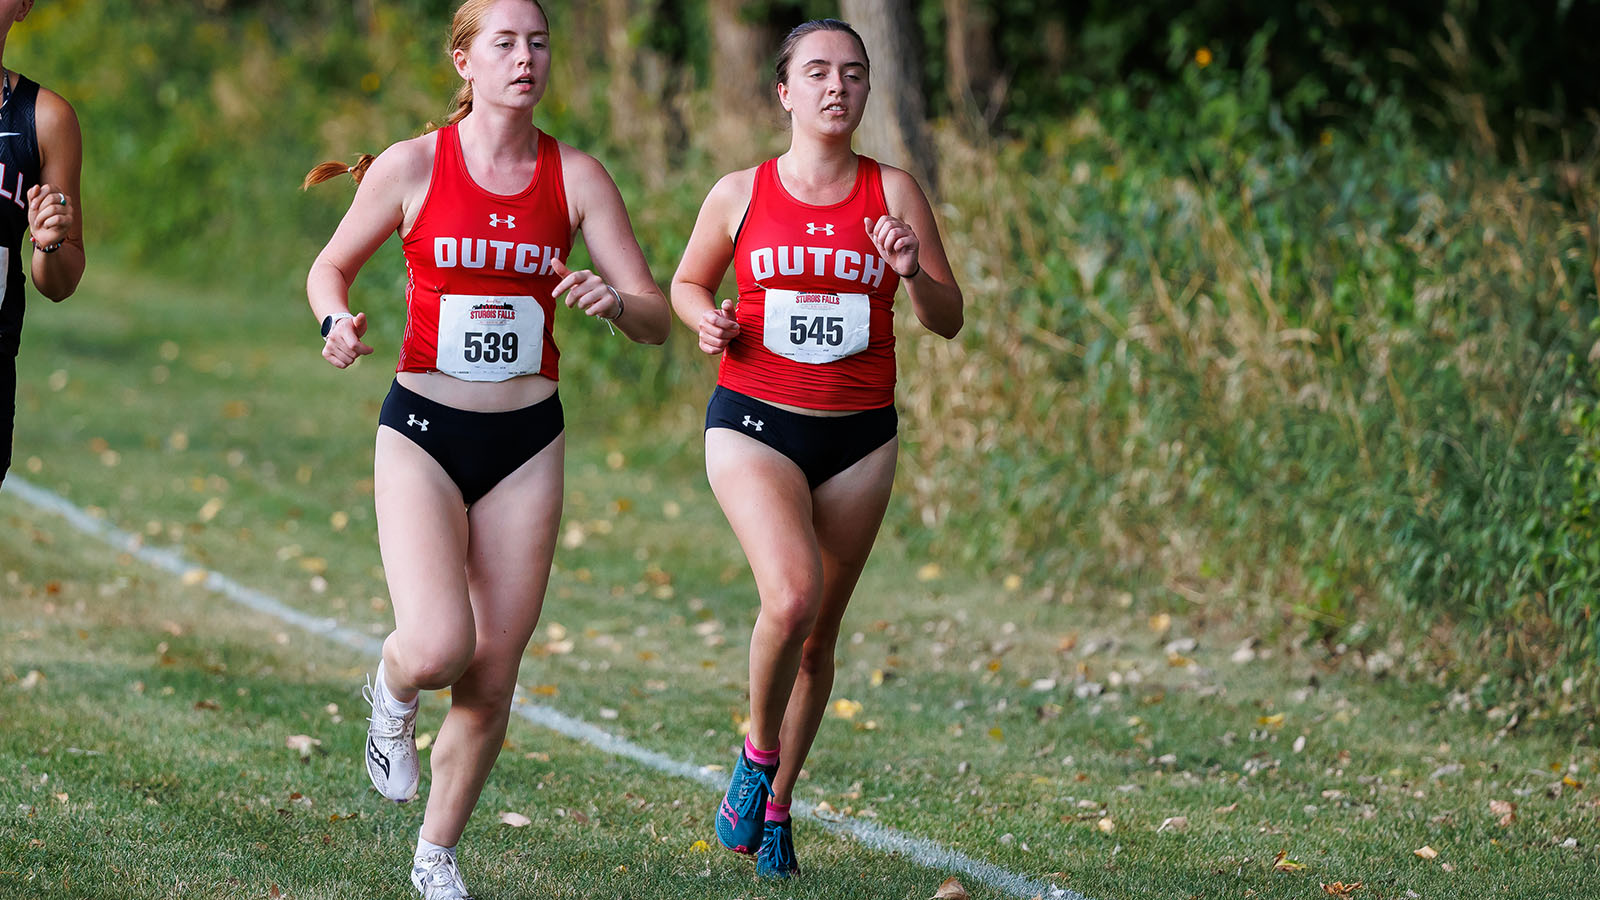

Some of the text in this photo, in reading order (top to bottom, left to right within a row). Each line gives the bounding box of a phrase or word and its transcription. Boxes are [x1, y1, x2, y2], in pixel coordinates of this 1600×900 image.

[434, 236, 560, 276] DUTCH
[750, 245, 886, 289] DUTCH
[470, 309, 516, 320] STURGIS FALLS
[795, 294, 840, 305] STURGIS FALLS
[464, 331, 519, 363] 539
[789, 315, 844, 347] 545
